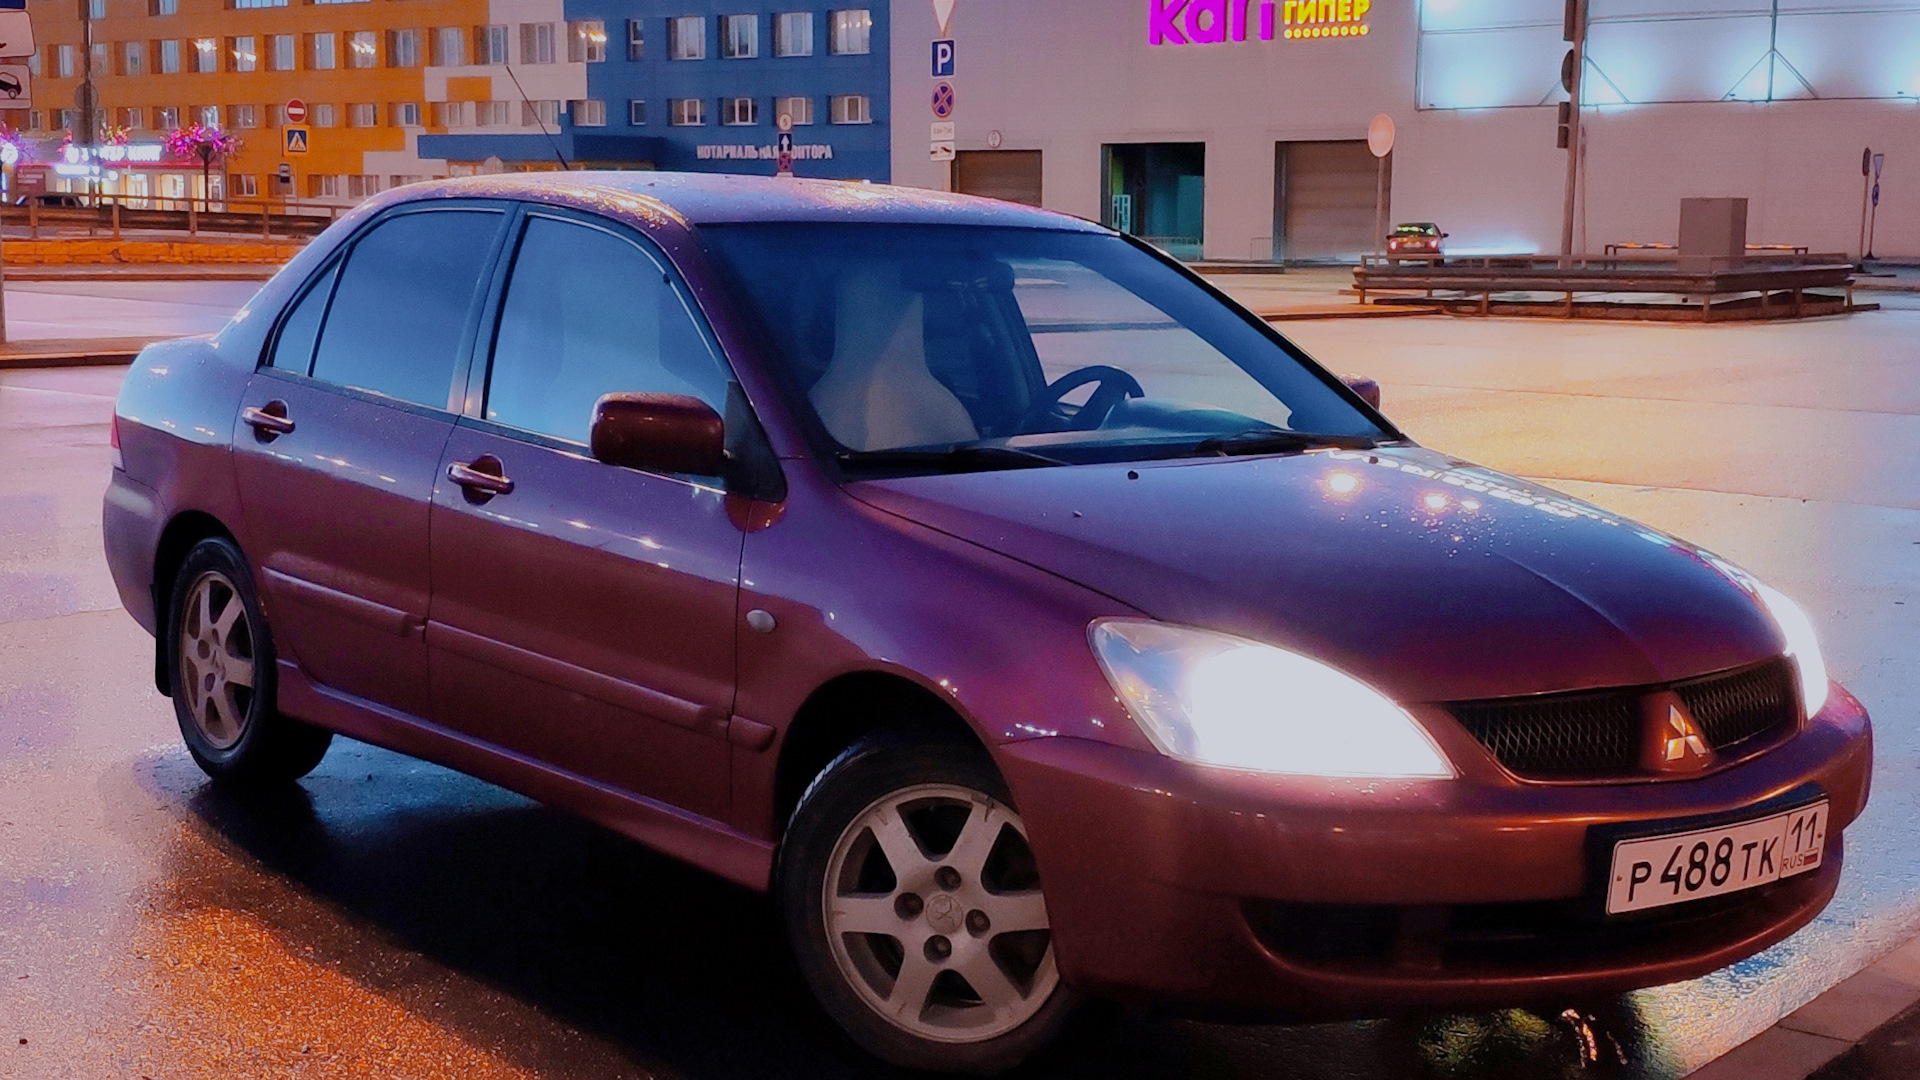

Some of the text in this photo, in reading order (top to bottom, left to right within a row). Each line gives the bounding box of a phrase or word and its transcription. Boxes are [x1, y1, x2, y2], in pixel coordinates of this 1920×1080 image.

[1149, 0, 1274, 45] kari
[1283, 0, 1371, 25] ГИПЕР
[937, 43, 952, 74] P
[781, 144, 833, 160] ОНТОРА
[1790, 811, 1817, 853] 11
[1782, 854, 1804, 873] RUS
